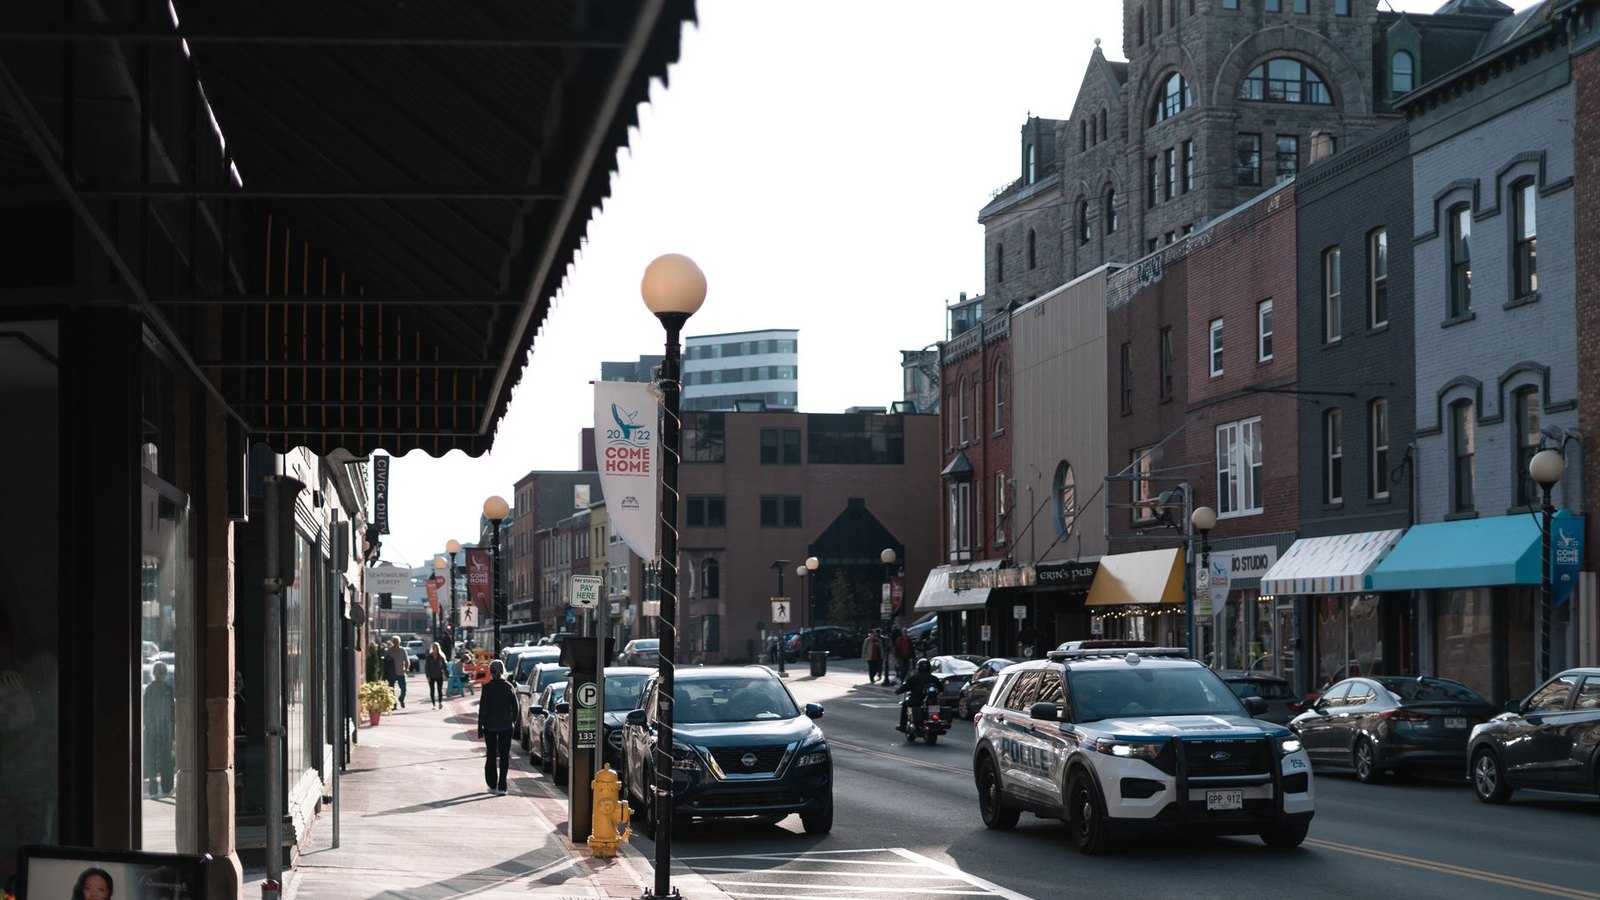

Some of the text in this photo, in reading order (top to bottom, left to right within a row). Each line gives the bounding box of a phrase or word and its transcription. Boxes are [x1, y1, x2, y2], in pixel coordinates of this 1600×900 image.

[607, 430, 650, 440] 20 22
[605, 447, 650, 460] COME
[606, 460, 650, 472] HOME
[1241, 554, 1269, 571] STUDIO
[576, 592, 596, 600] HERE
[585, 688, 596, 703] P
[1208, 794, 1241, 804] GPP 912
